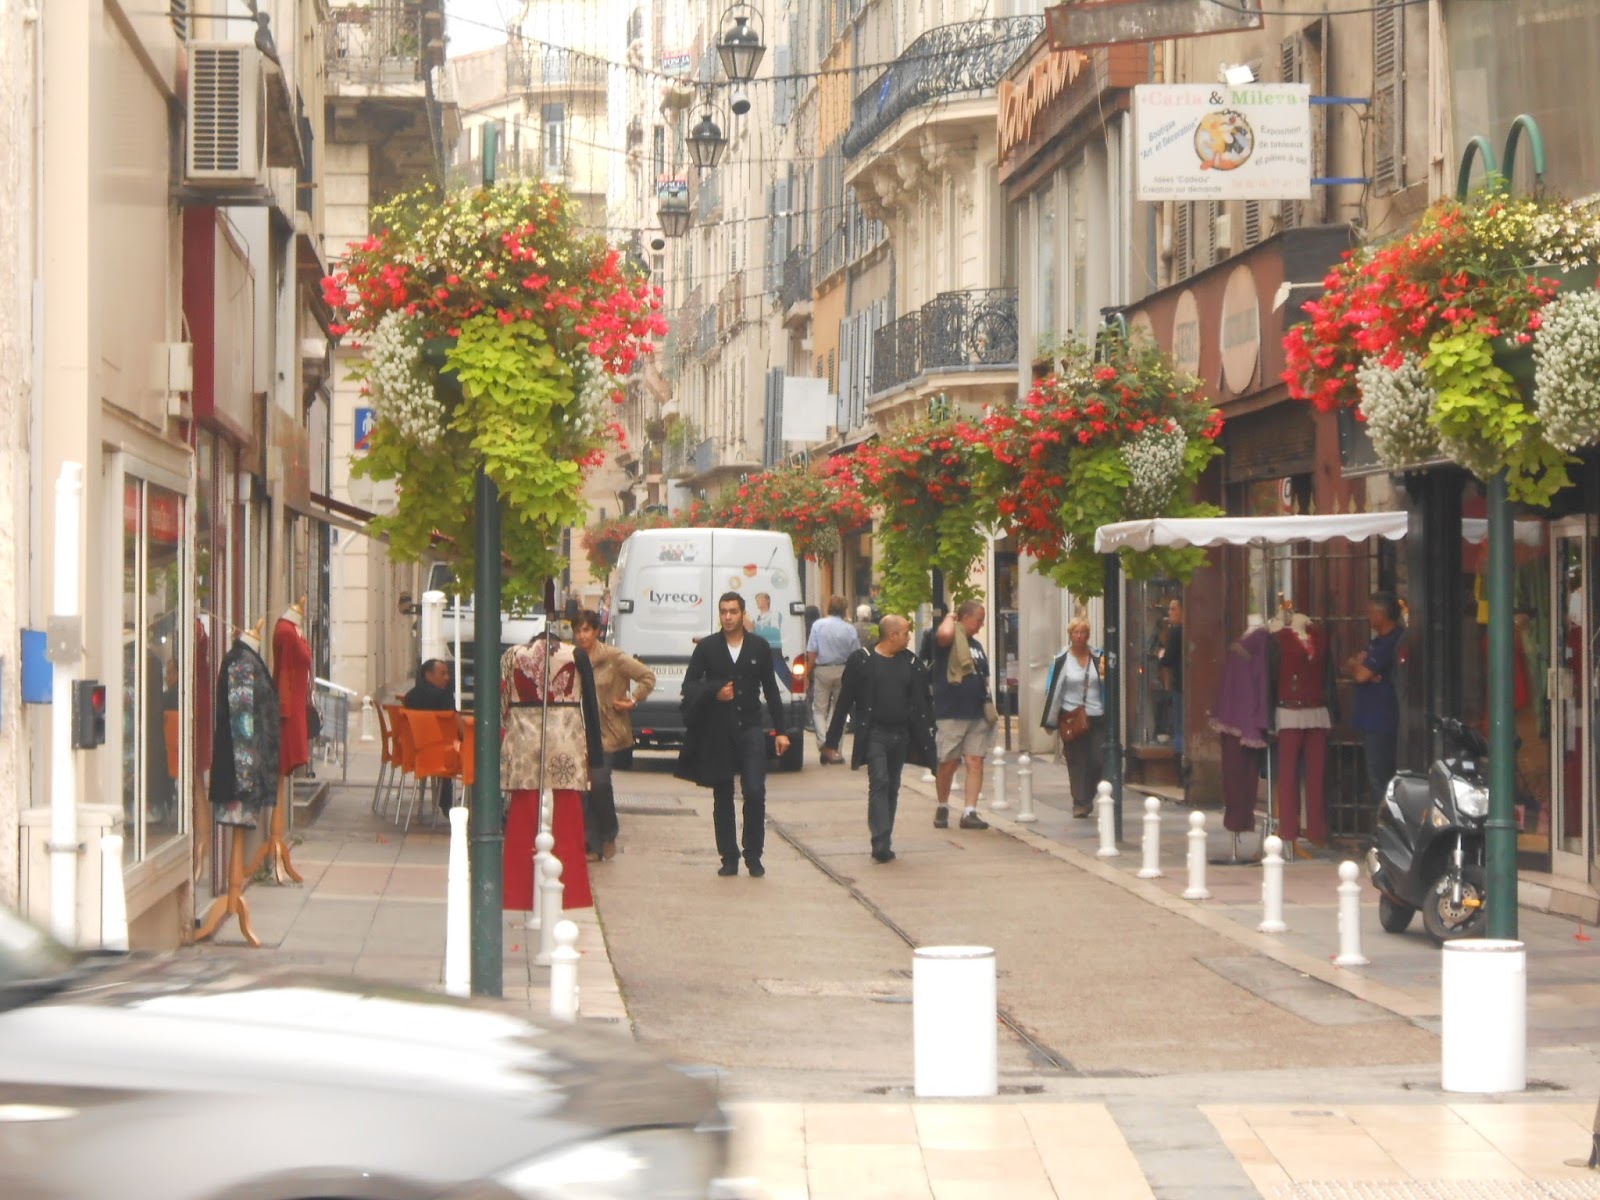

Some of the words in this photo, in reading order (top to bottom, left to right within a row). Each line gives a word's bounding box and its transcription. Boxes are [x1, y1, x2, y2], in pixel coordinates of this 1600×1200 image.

[1209, 91, 1224, 105] &
[1232, 90, 1298, 105] Mileva
[1260, 125, 1301, 135] Exposition
[1259, 140, 1269, 149] de
[1270, 140, 1303, 149] tableaux
[1188, 185, 1222, 193] demande
[650, 590, 699, 605] Lyreco
